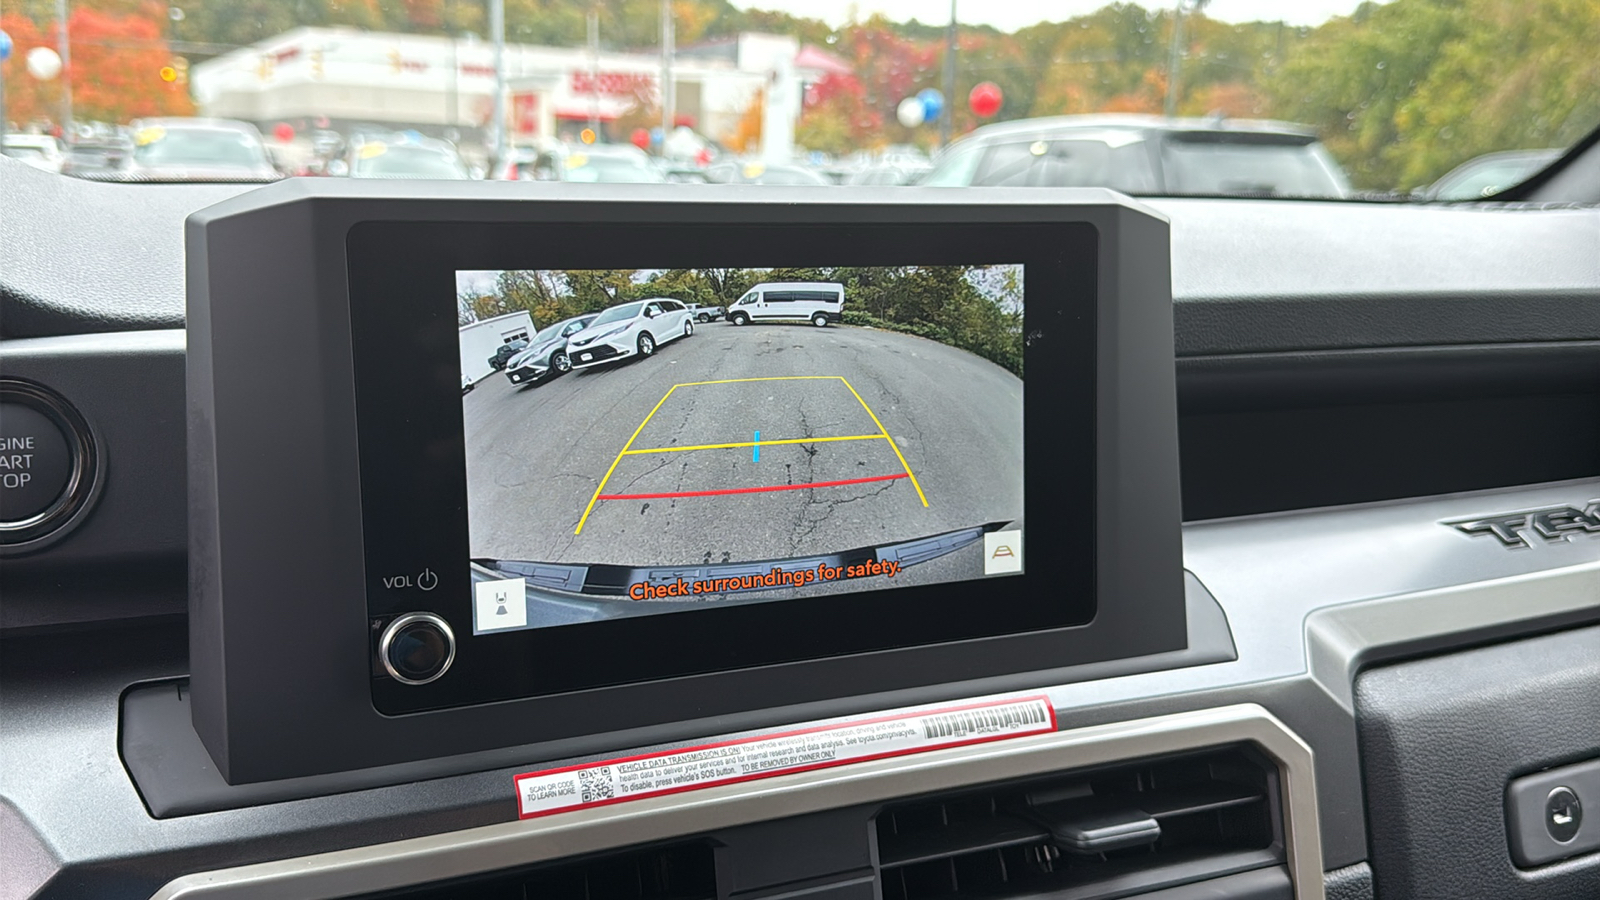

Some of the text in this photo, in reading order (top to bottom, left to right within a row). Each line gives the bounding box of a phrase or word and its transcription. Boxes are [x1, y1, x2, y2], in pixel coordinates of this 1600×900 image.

[0, 473, 31, 489] OP
[383, 575, 414, 589] VOL
[629, 559, 903, 600] Check surroundings for safety.
[616, 762, 647, 774] VEHICLE
[648, 759, 667, 769] DATA
[668, 750, 719, 765] TRANSMISSION
[720, 748, 728, 756] IS
[741, 744, 755, 753] Your
[756, 741, 777, 750] vehicle
[619, 773, 639, 783] health
[640, 770, 654, 779] data
[655, 769, 662, 777] to
[663, 765, 683, 776] deliver
[684, 764, 698, 775] your
[699, 760, 725, 771] services
[725, 756, 737, 766] and
[737, 755, 746, 764] for
[746, 751, 768, 761] internal
[769, 748, 794, 758] research
[795, 745, 806, 754] and
[807, 743, 820, 752] data
[846, 736, 858, 746] See
[620, 749, 836, 793] To disable, press vehicle's SOS button. TO BE REMOVED BY OWNER ONLY
[527, 786, 576, 802] TO LEARN MORE
[529, 783, 547, 793] SCAN
[558, 780, 575, 790] CODE
